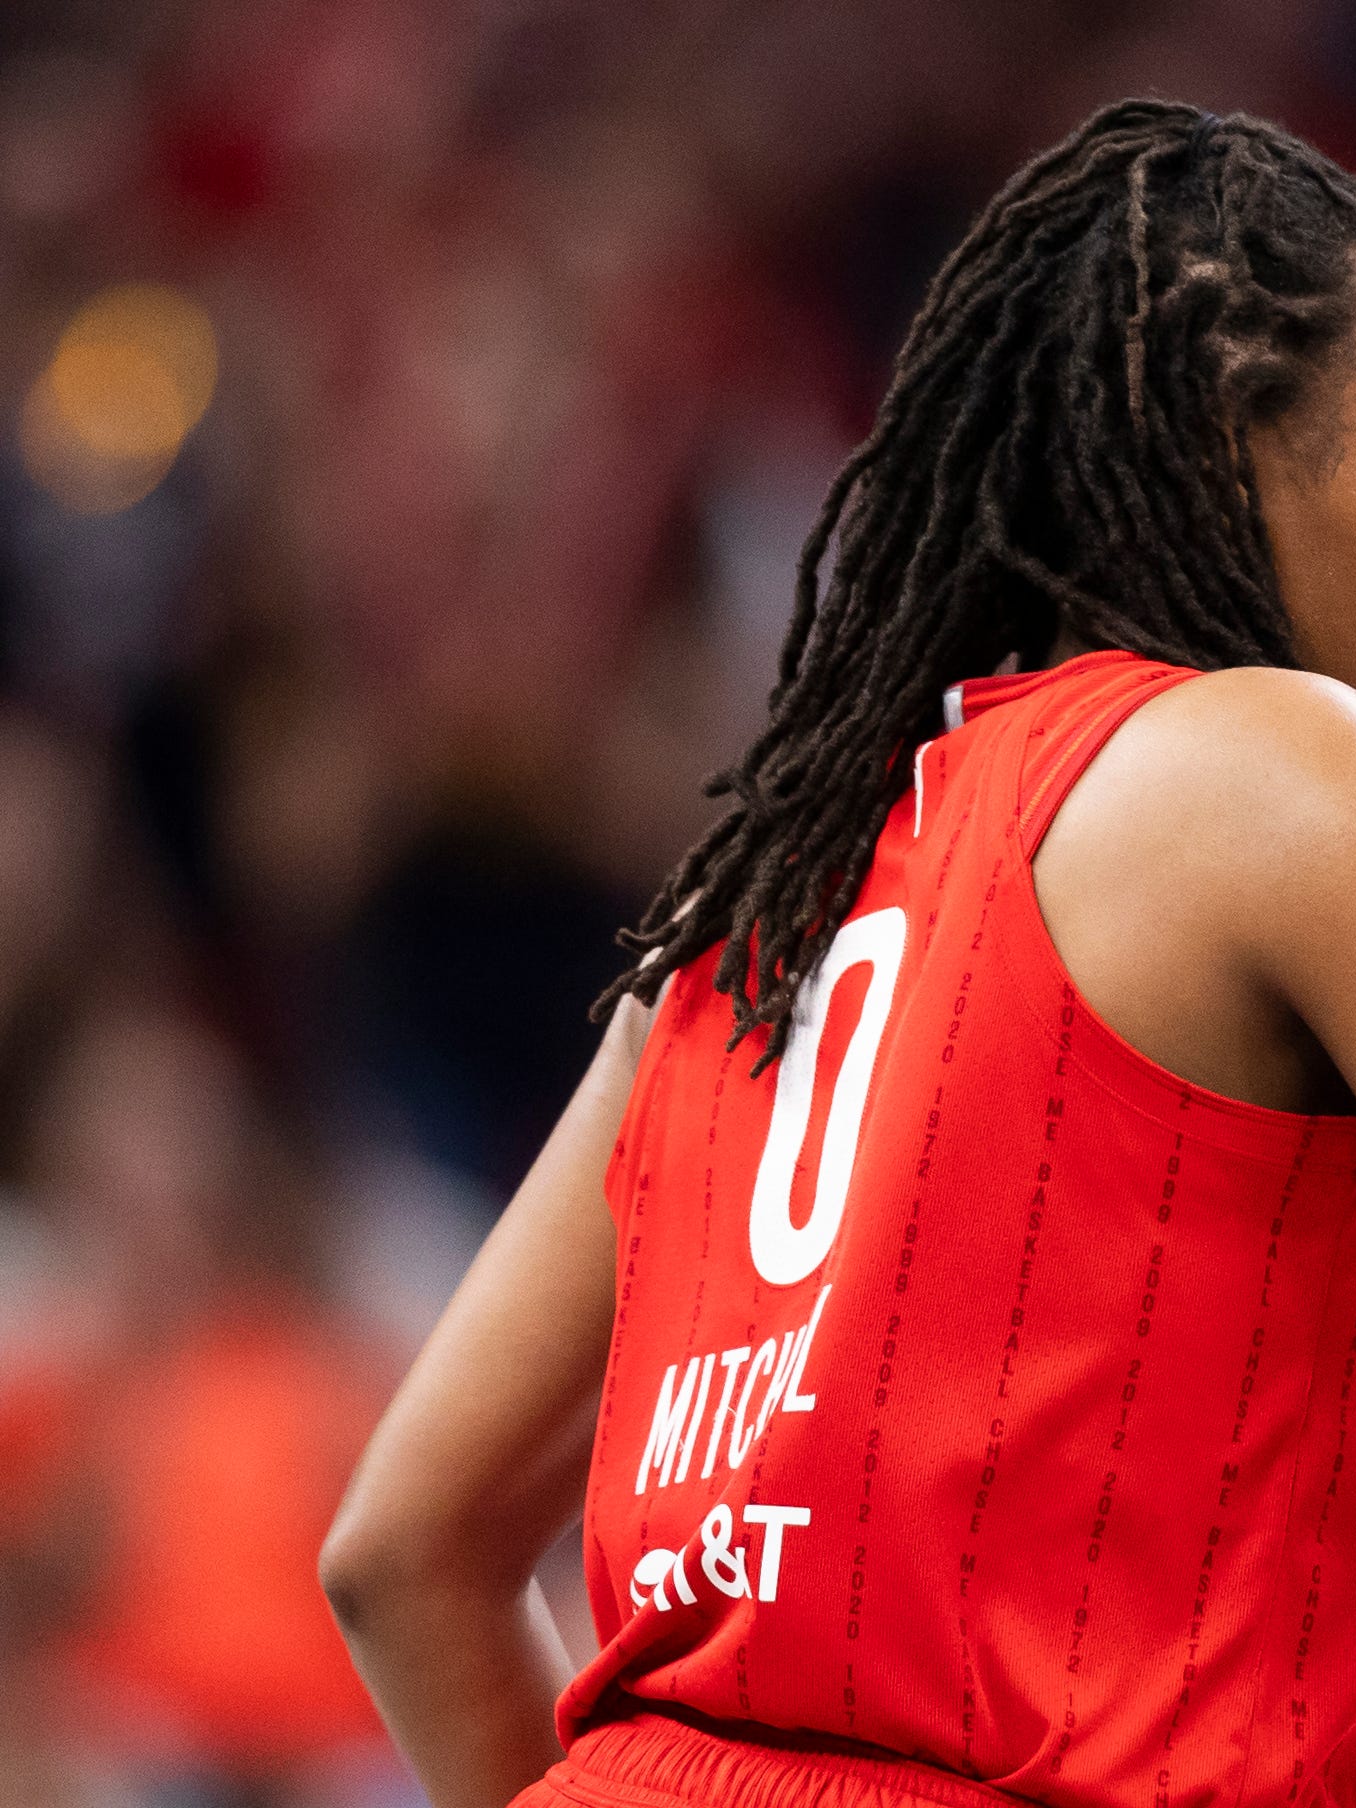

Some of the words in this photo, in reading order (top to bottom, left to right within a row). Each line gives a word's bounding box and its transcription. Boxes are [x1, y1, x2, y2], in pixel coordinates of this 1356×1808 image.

[940, 971, 973, 1065] 2020
[1056, 981, 1077, 1077] HOSE
[748, 906, 907, 1286] 0
[916, 1085, 944, 1181] 1972
[1044, 1096, 1065, 1143] ME
[1156, 1132, 1184, 1225] 1999
[1262, 1118, 1317, 1308] SKETBALL
[894, 1198, 922, 1295] 1999
[997, 1162, 1052, 1399] BASKETBALL
[1135, 1244, 1164, 1338] 2009
[872, 1314, 901, 1408] 2009
[1110, 1358, 1142, 1451] 2012
[1231, 1327, 1265, 1443] CHOSE
[857, 1428, 882, 1524] 2012
[969, 1417, 1004, 1534] CHOSE
[1086, 1471, 1117, 1563] 2020
[1218, 1462, 1240, 1508] ME
[846, 1545, 867, 1641] 2020
[959, 1552, 977, 1598] ME
[1294, 1564, 1321, 1681] CHOSE
[1065, 1584, 1090, 1676] 1972
[1163, 1526, 1220, 1752] BASKETBALL
[843, 1663, 857, 1730] 197
[1290, 1699, 1308, 1741] ME
